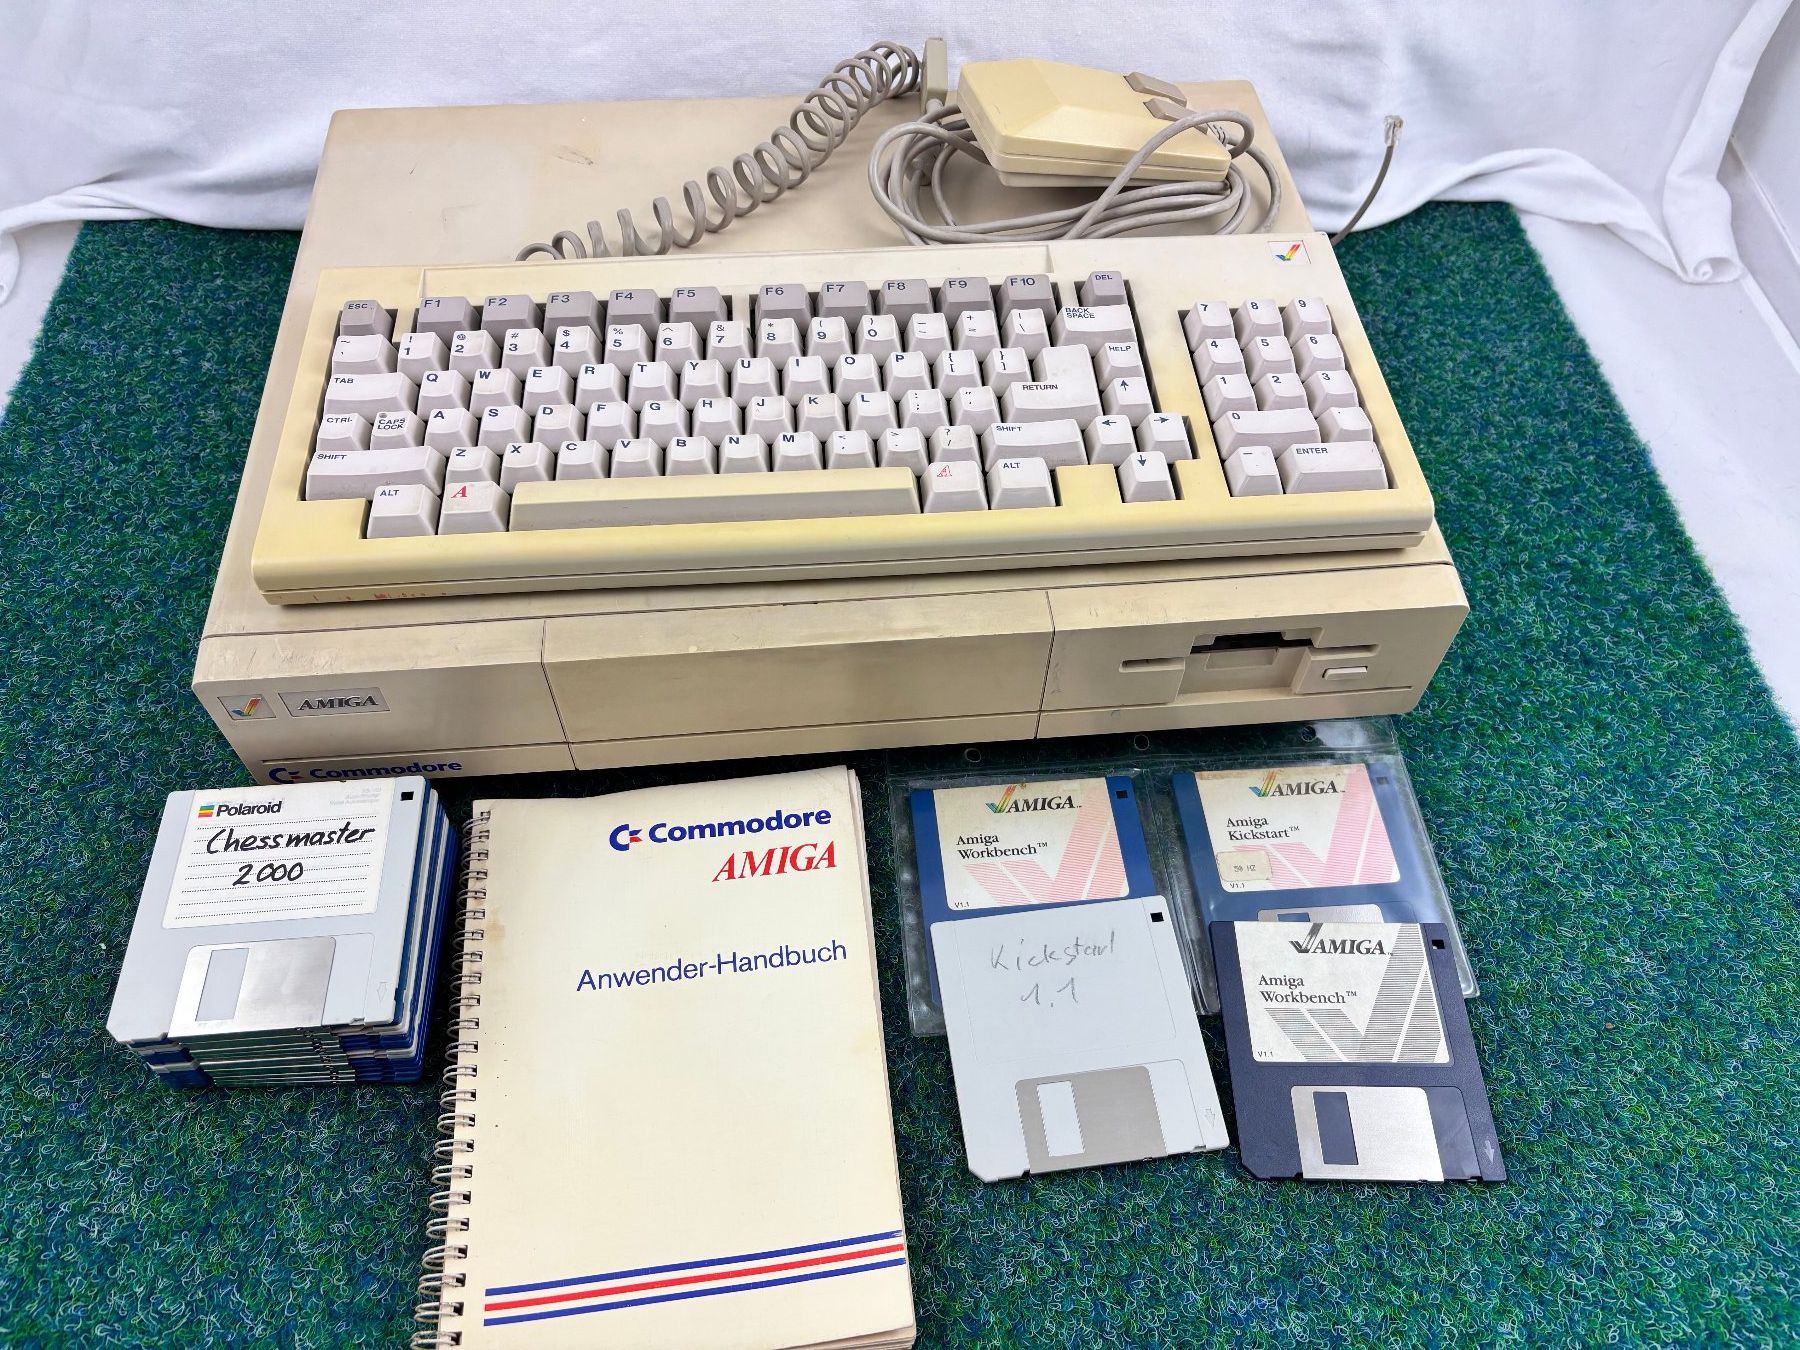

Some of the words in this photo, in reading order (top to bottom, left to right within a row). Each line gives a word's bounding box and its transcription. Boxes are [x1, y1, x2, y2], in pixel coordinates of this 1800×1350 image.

[886, 281, 906, 291] F8
[948, 279, 968, 289] F9
[1009, 277, 1036, 286] F10
[764, 287, 784, 296] F6
[825, 283, 845, 293] F7
[614, 292, 634, 301] F4
[676, 289, 696, 298] F5
[423, 299, 441, 308] F1
[488, 298, 507, 307] F2
[550, 294, 570, 304] F3
[1298, 299, 1307, 308] 9
[1065, 306, 1090, 314] BACK
[1200, 303, 1208, 312] 7
[1250, 301, 1259, 310] 8
[715, 335, 725, 344] 7
[766, 332, 776, 341] 8
[816, 330, 827, 340] 9
[559, 340, 570, 350] 4
[612, 339, 622, 348] 5
[662, 337, 673, 346] 6
[1210, 340, 1219, 349] 4
[1261, 338, 1269, 347] 5
[1309, 336, 1318, 345] 6
[404, 347, 410, 356] 1
[454, 344, 464, 353] 2
[508, 343, 518, 352] 3
[1108, 345, 1132, 353] HELP
[844, 355, 856, 365] O
[895, 354, 905, 363] P
[637, 363, 648, 373] T
[689, 361, 700, 371] Y
[741, 359, 751, 369] U
[478, 369, 491, 380] W
[532, 369, 543, 378] E
[584, 366, 596, 375] R
[426, 373, 439, 383] Q
[1220, 376, 1227, 385] 1
[1271, 375, 1282, 384] 2
[1321, 372, 1331, 381] 3
[1022, 383, 1058, 391] RETURN
[756, 399, 765, 407] J
[808, 396, 819, 405] K
[860, 394, 870, 403] L
[596, 403, 606, 412] F
[649, 402, 661, 411] G
[702, 399, 713, 408] H
[433, 410, 445, 419] A
[488, 408, 499, 417] S
[542, 406, 554, 415] D
[378, 417, 406, 425] CAPS
[676, 438, 687, 447] B
[728, 437, 740, 445] N
[782, 434, 795, 443] M
[565, 442, 577, 451] C
[620, 439, 631, 449] V
[455, 449, 466, 457] Z
[510, 445, 522, 454] X
[1295, 447, 1328, 455] ENTER
[316, 453, 348, 461] SHIFT
[379, 489, 400, 497] ALT
[297, 695, 379, 711] AMIGA
[309, 760, 463, 780] Commodore
[1270, 779, 1338, 797] AMIGA
[1005, 795, 1076, 813] AMIGA
[215, 800, 283, 818] Polaroid
[648, 809, 832, 844] Commodore
[1226, 816, 1268, 829] Amiga
[955, 832, 1000, 846] Amiga
[711, 840, 838, 883] AMIGA
[232, 861, 304, 887] 2000
[1310, 939, 1386, 955] AMIGA
[576, 939, 847, 992] Anwender-Handbuch
[1258, 974, 1304, 988] Amiga
[1020, 977, 1079, 1008] 1.1
